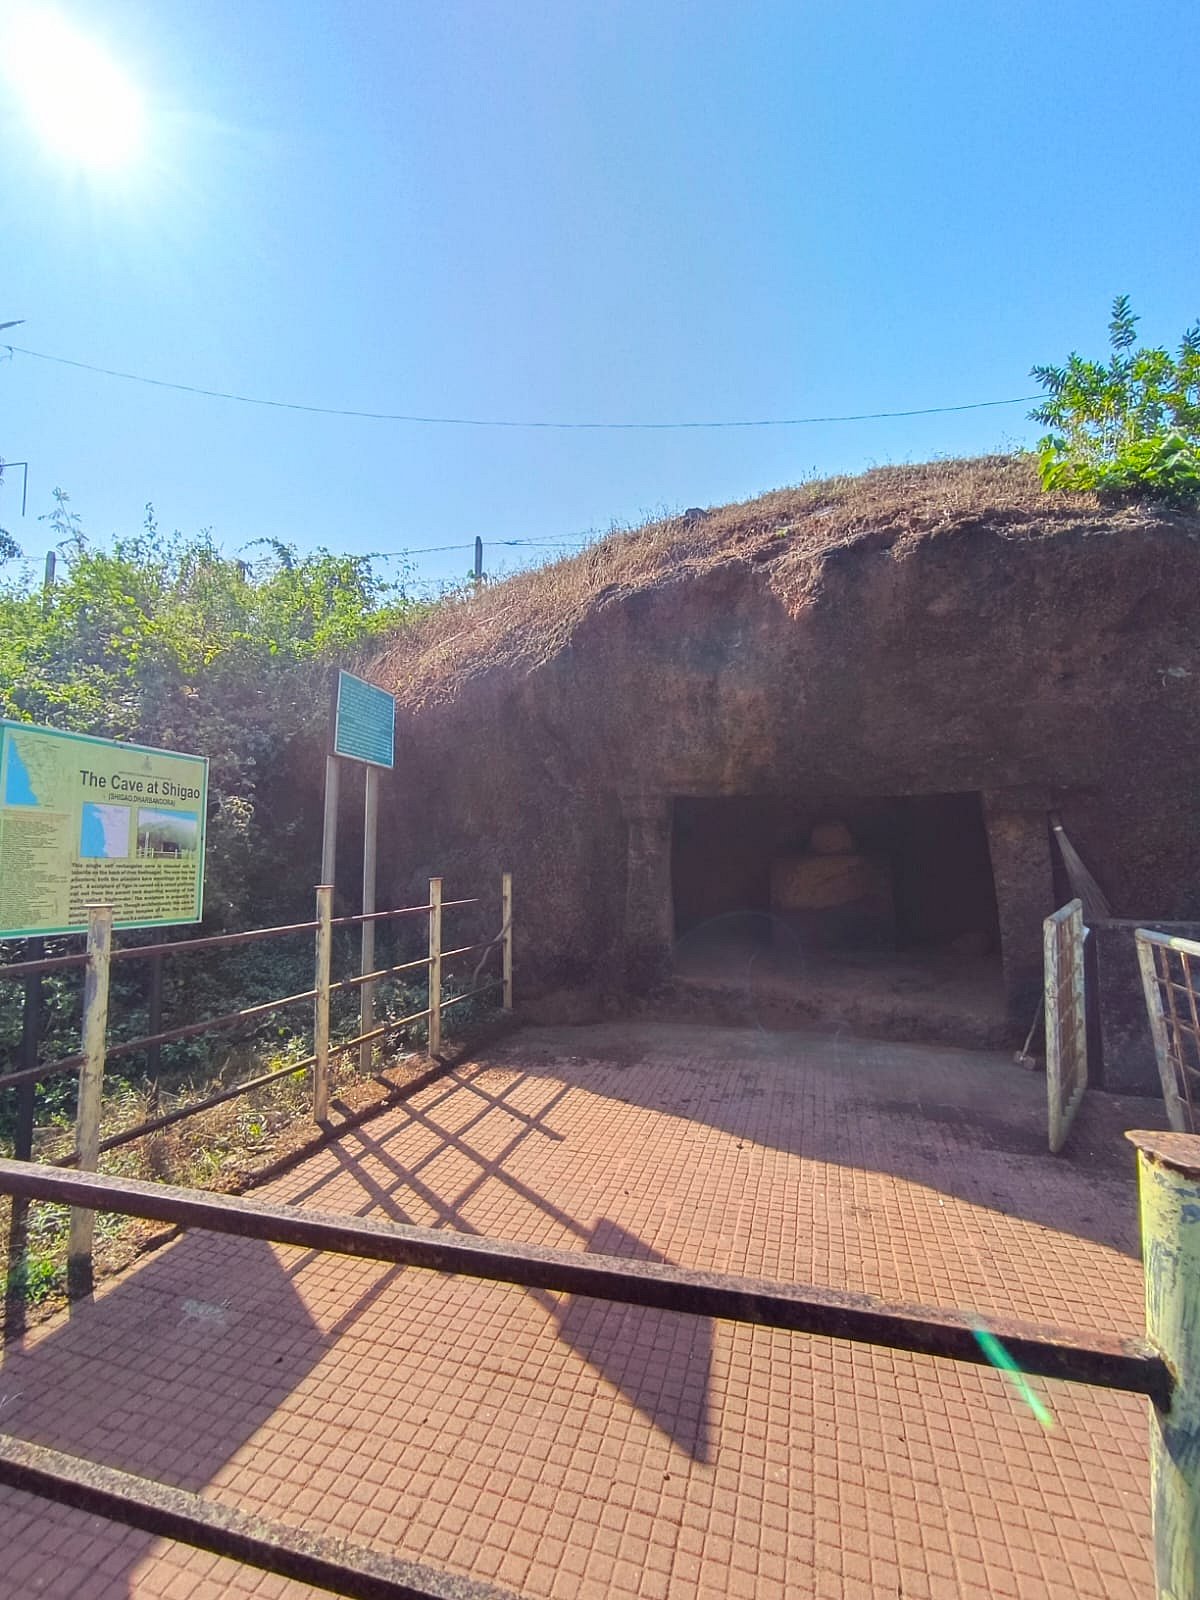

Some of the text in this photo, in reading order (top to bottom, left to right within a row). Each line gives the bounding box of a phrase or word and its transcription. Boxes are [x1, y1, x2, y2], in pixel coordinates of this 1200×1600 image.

[80, 770, 106, 788] The
[111, 775, 143, 792] Cave
[147, 781, 158, 794] at
[162, 782, 200, 800] Shigao
